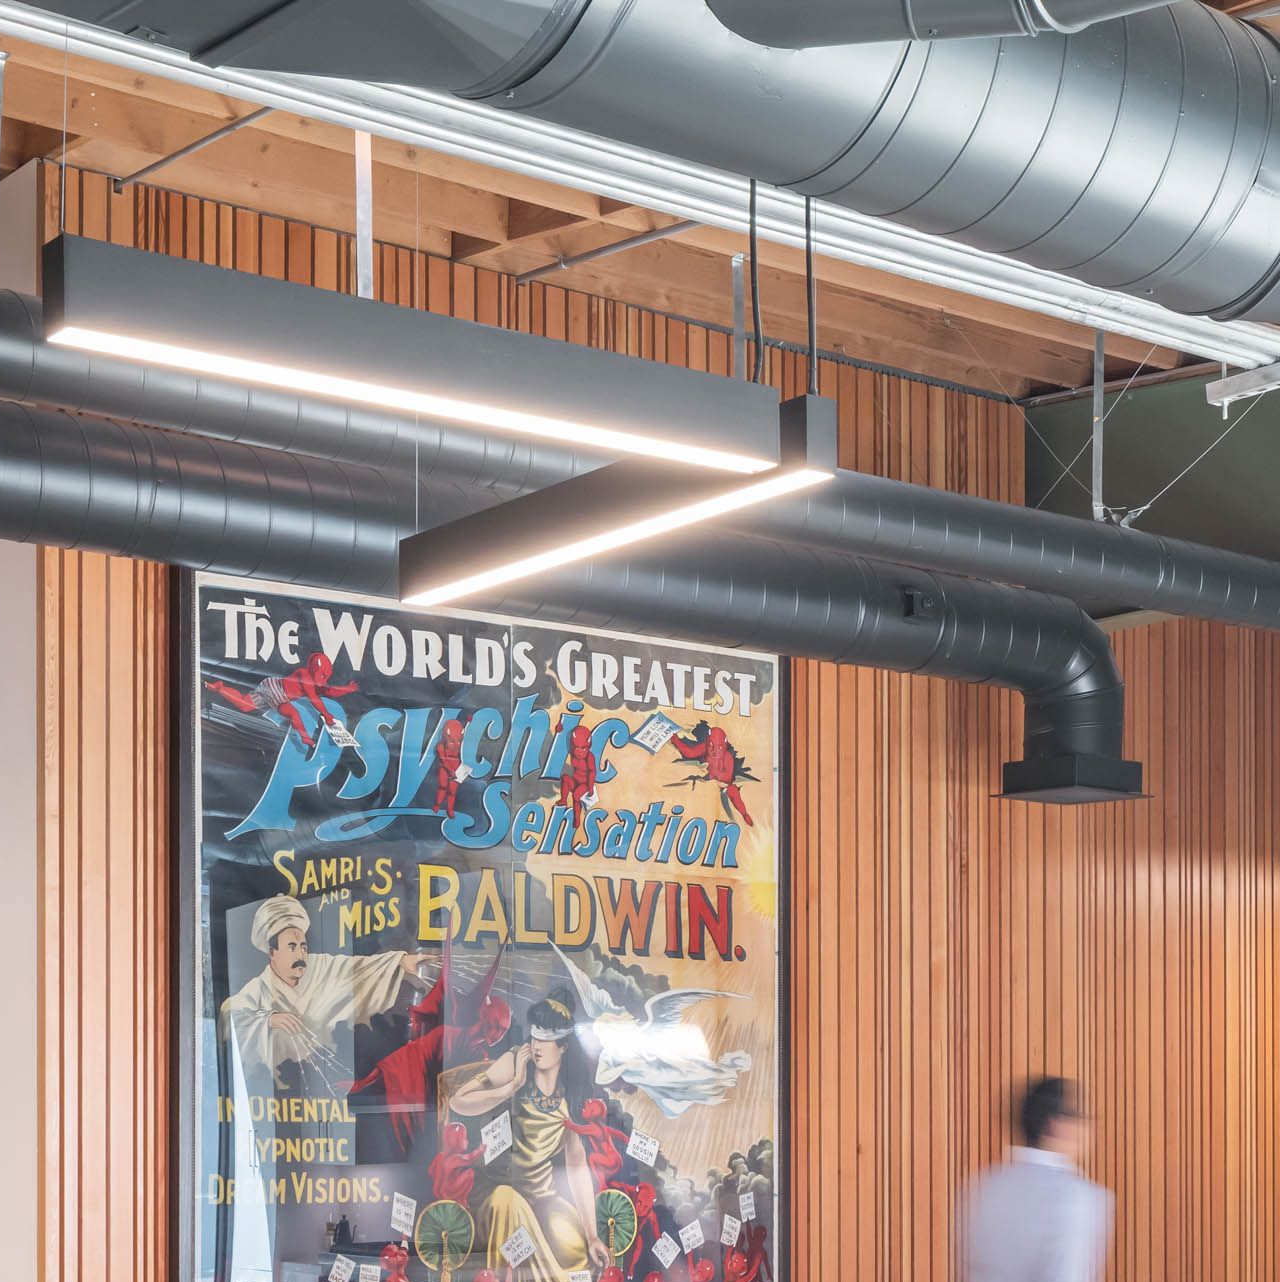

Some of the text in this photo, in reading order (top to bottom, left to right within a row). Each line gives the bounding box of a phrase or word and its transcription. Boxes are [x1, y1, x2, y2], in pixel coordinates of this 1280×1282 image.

[313, 607, 535, 688] WORLD'S
[556, 640, 758, 717] GREATEST
[440, 778, 743, 869] Sensation
[273, 848, 362, 899] SAMRI
[318, 887, 352, 908] AND
[338, 897, 401, 947] MISS
[416, 863, 747, 962] BALDWIN.
[249, 1096, 357, 1124] ORIENTAL
[254, 1137, 349, 1163] YPNOTIC
[291, 1171, 390, 1204] VISIONS.
